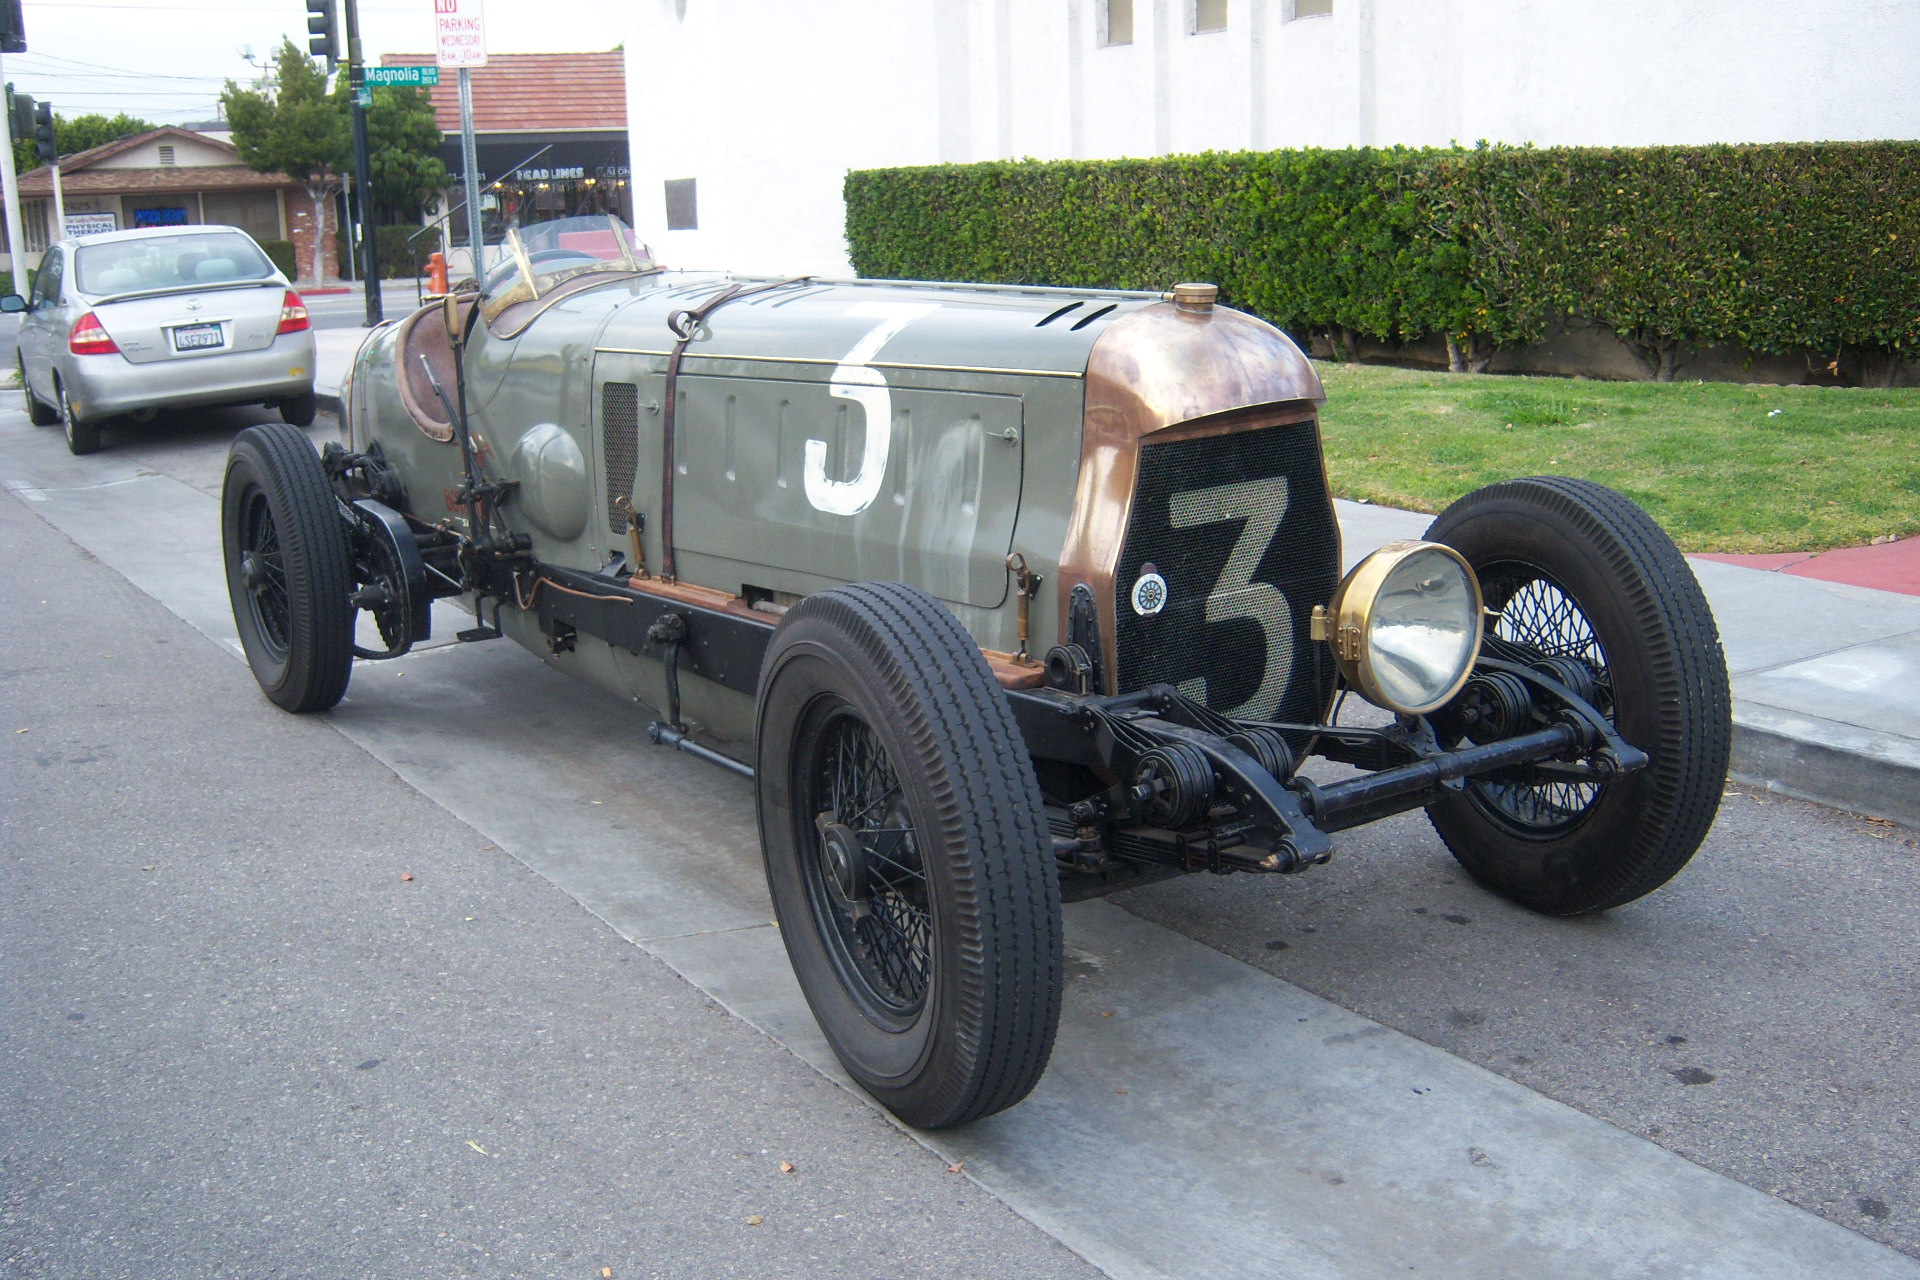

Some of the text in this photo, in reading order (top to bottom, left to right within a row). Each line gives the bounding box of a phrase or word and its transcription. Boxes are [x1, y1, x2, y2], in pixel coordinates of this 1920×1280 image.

[440, 17, 481, 31] PARKING
[441, 34, 481, 47] WEDNESDAY
[365, 67, 420, 86] Magnolia
[421, 67, 436, 76] BLVD
[804, 301, 943, 516] 3
[1169, 475, 1295, 722] 3
